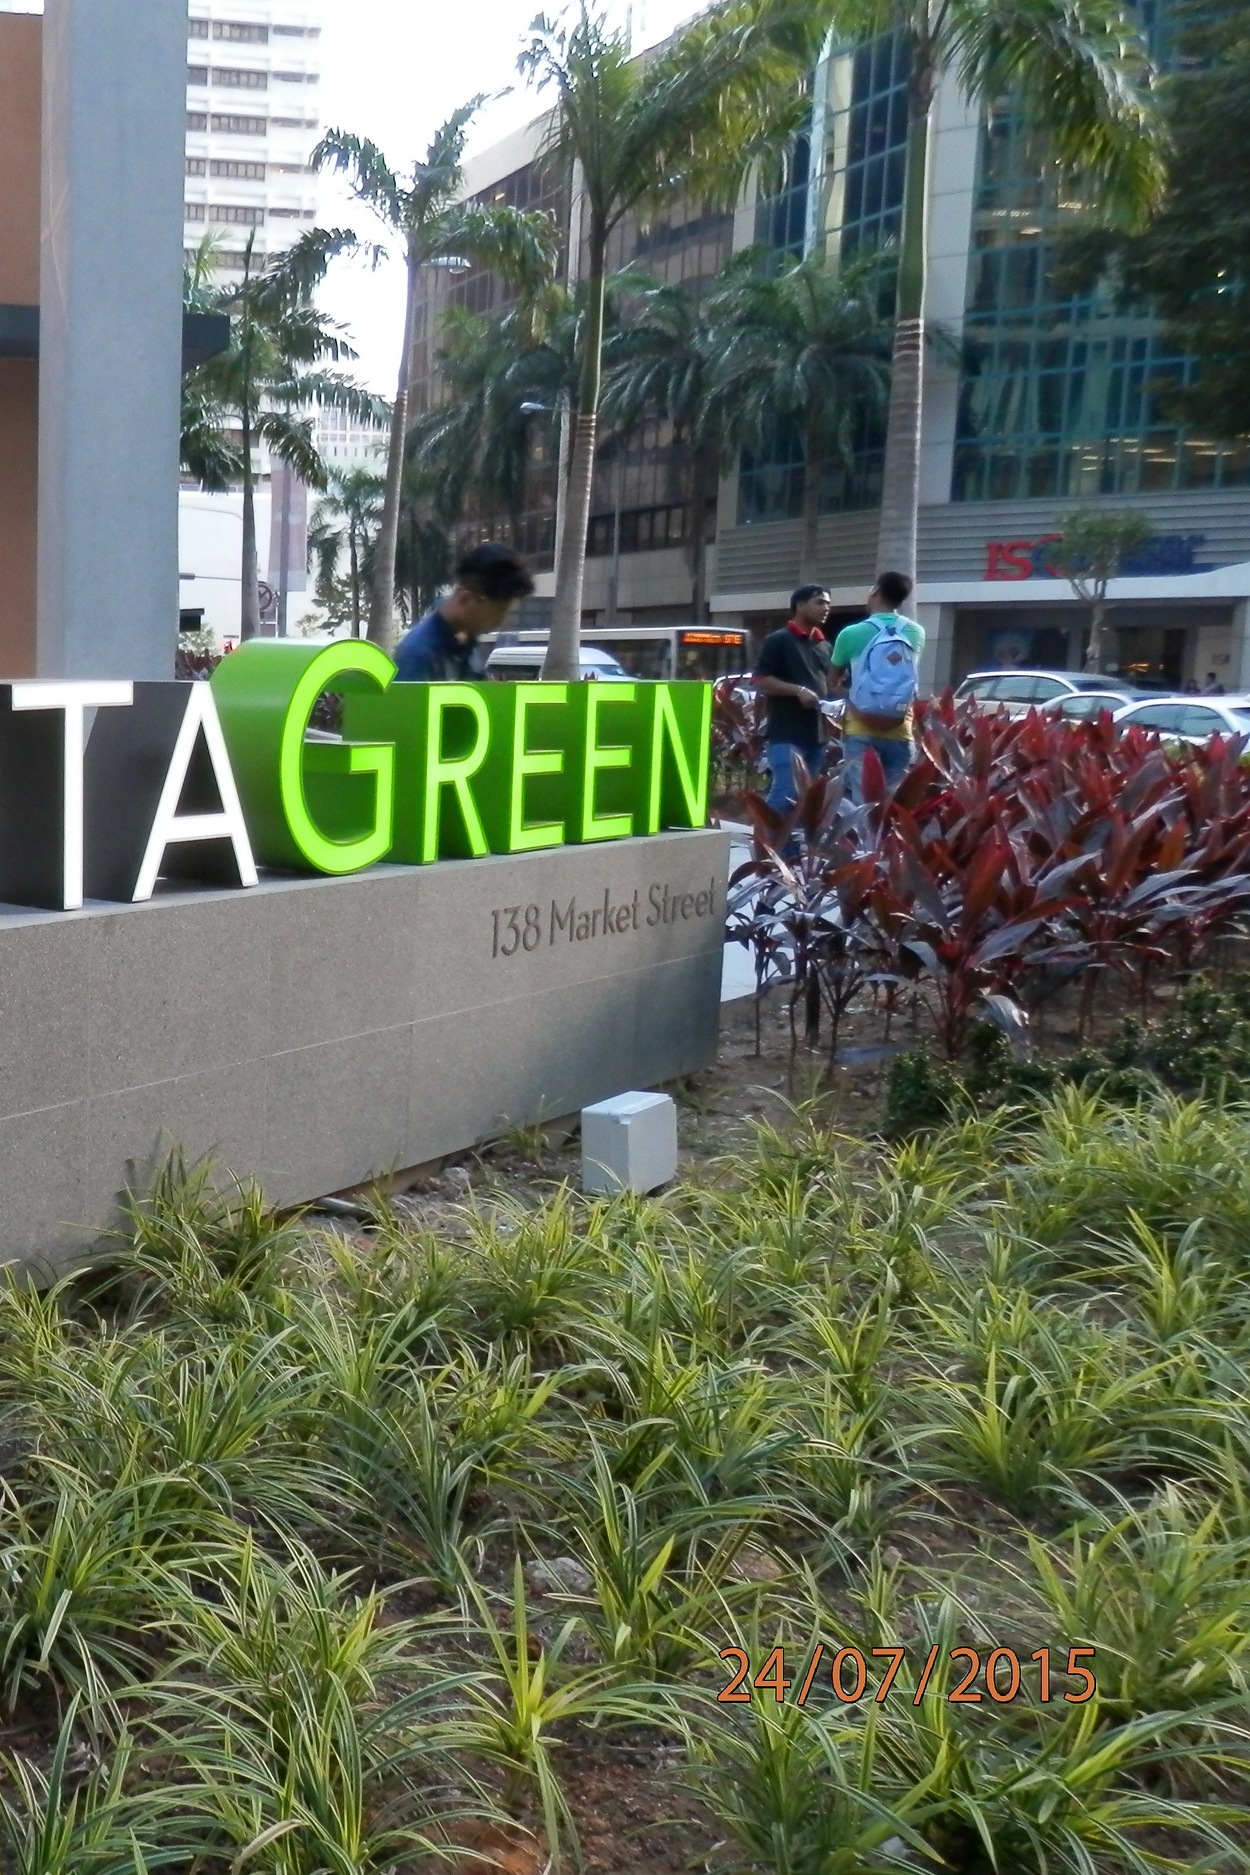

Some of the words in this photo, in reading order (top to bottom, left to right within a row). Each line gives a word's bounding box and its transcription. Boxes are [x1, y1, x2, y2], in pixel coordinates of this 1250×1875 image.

[490, 904, 542, 959] 138
[549, 887, 639, 947] Market
[646, 876, 716, 926] Street
